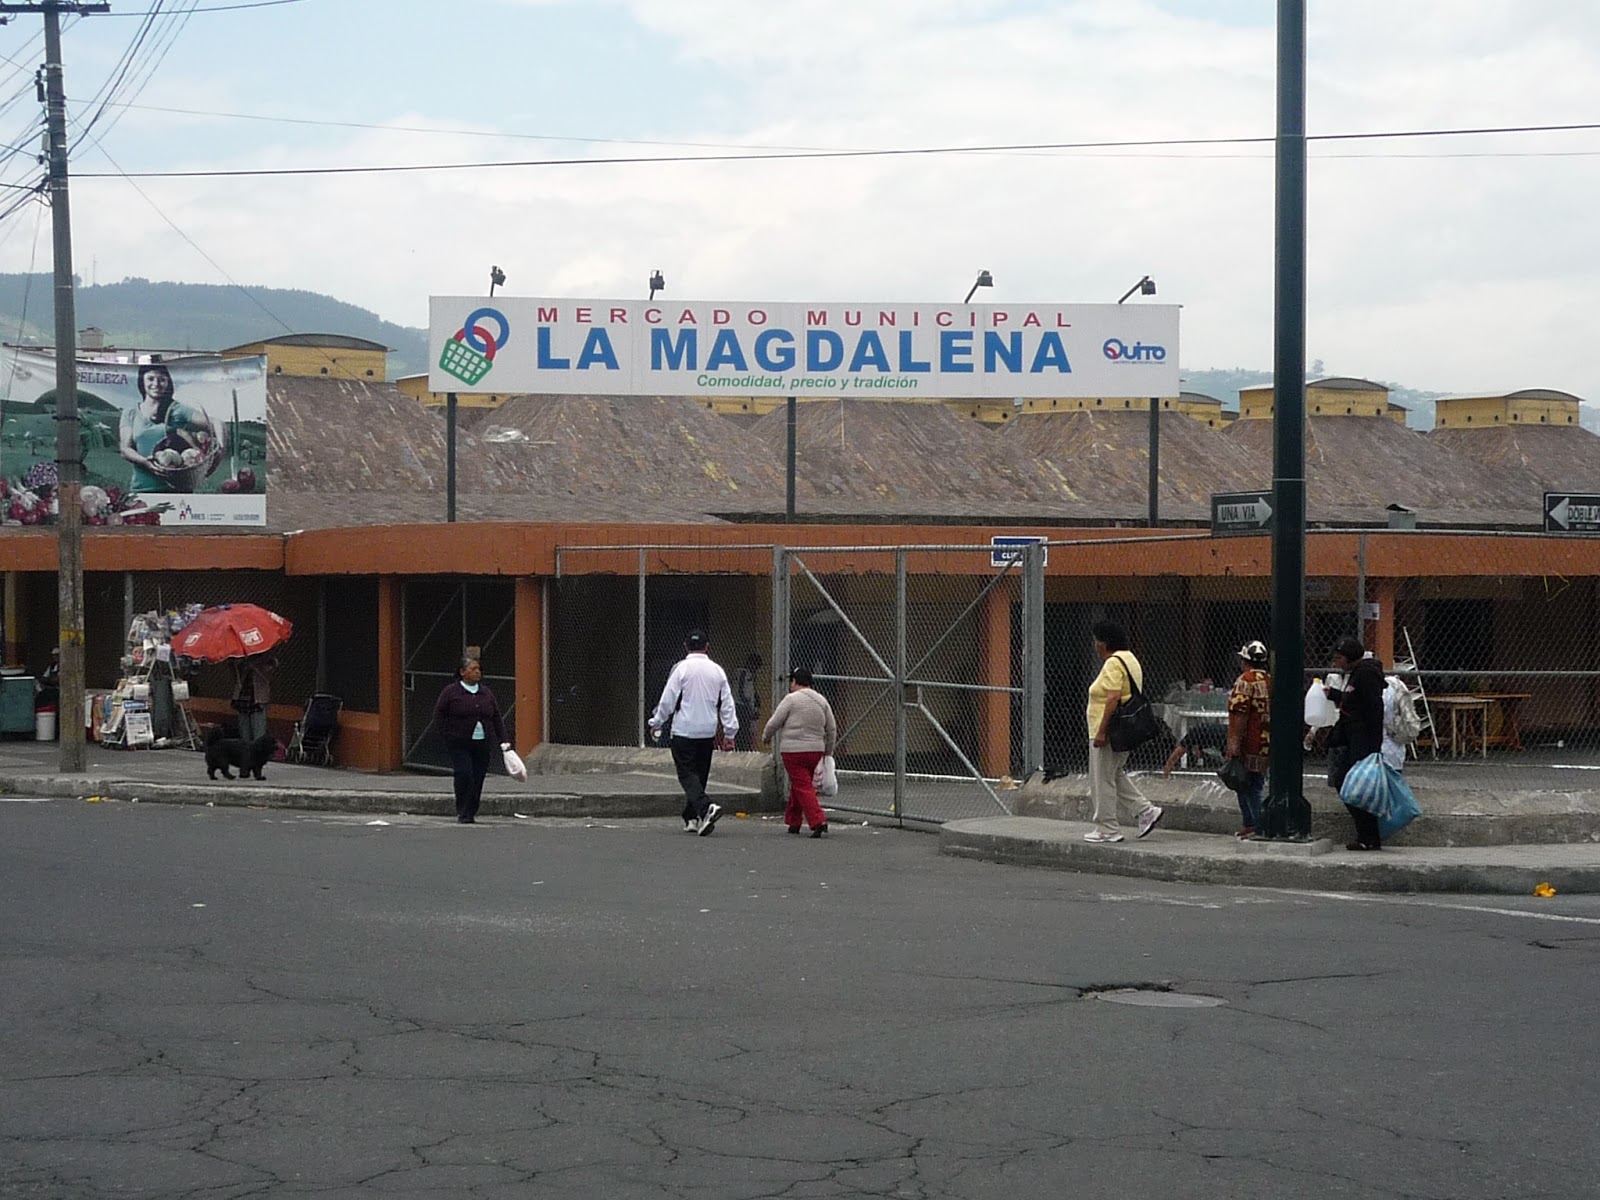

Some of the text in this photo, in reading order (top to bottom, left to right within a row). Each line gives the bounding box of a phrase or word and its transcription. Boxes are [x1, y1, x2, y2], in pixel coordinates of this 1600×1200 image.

[536, 307, 1072, 328] MERCADO MUNICIPAL
[537, 326, 1073, 374] LA MAGDALENA
[697, 375, 919, 390] Comodidad, precio y tradición
[1221, 505, 1256, 521] UNA VIA
[1568, 507, 1594, 521] DOBLE
